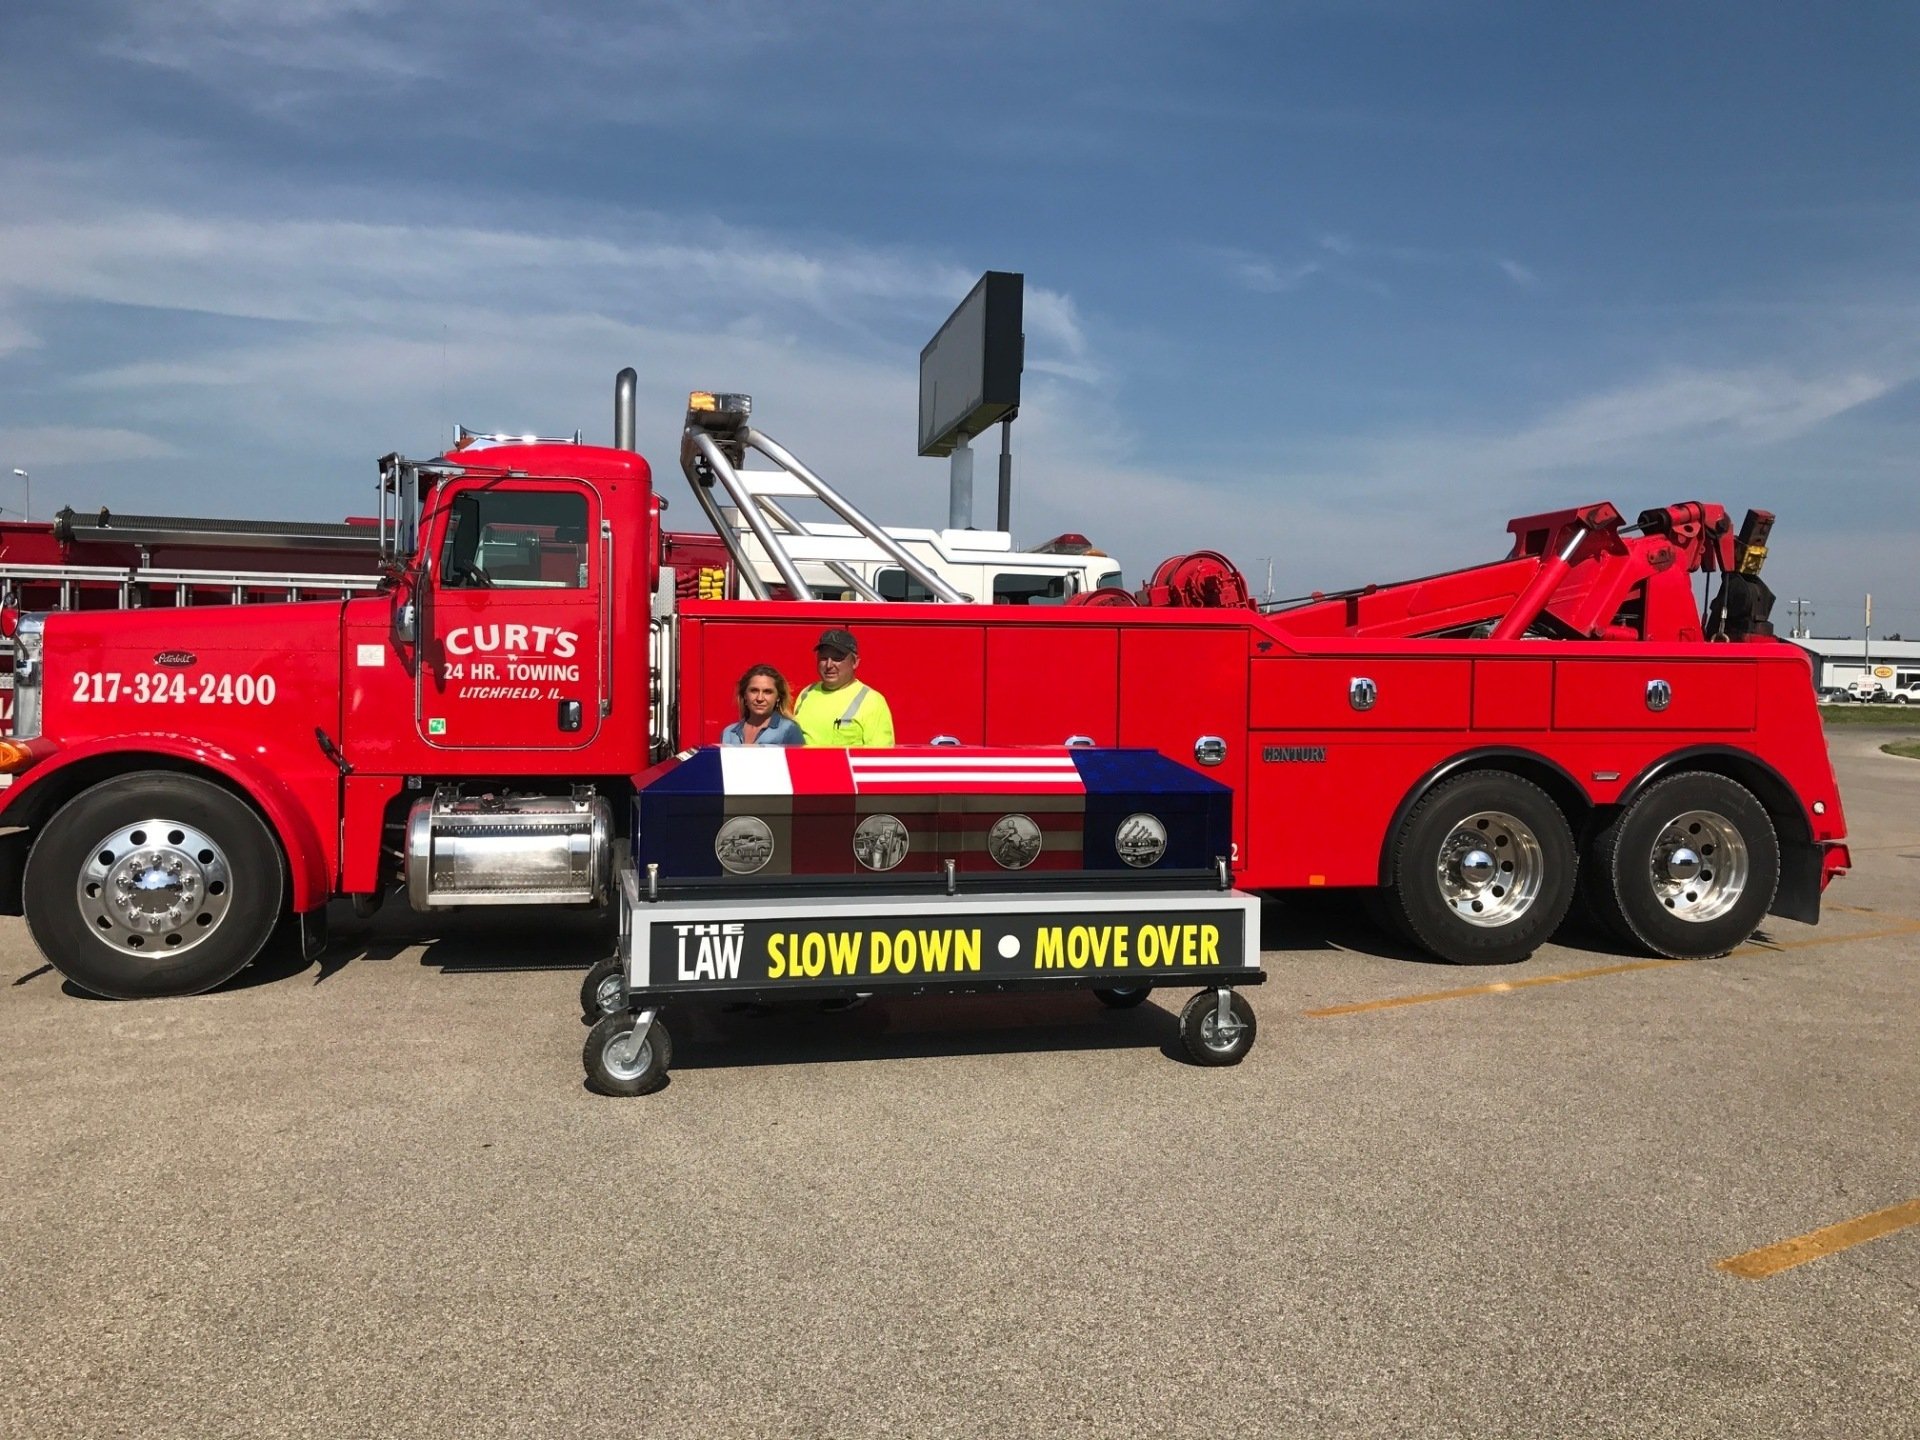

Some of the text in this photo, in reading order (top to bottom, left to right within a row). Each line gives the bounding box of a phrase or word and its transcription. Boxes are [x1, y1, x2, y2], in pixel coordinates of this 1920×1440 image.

[446, 624, 579, 658] CURT'S
[157, 653, 192, 664] Peterbilt
[444, 663, 580, 682] 24 HR. TOWING
[72, 671, 276, 705] 217-324-2400
[459, 687, 565, 700] LITCHFIELD, IL.
[1263, 746, 1327, 762] CENTURY
[673, 923, 745, 936] THE
[678, 935, 745, 981] LAW
[767, 924, 1220, 979] SLOW DOWN MOVE OVER
